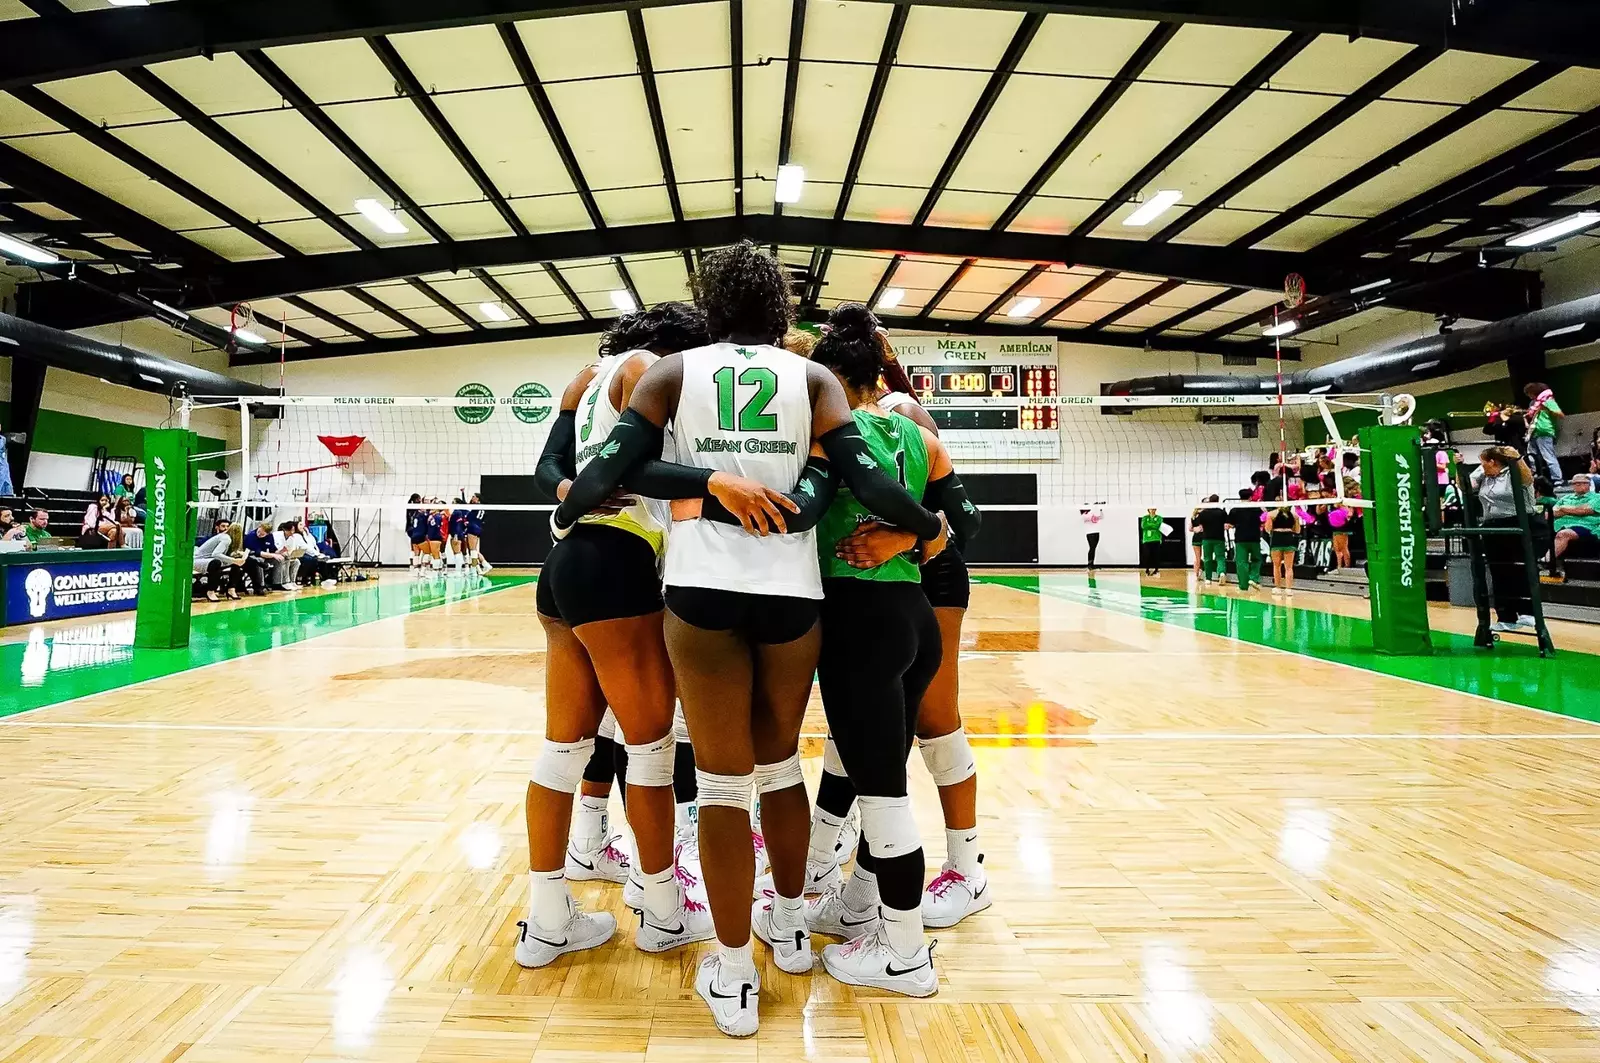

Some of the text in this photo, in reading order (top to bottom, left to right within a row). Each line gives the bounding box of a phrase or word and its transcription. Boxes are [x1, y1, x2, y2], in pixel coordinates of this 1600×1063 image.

[937, 340, 976, 349] MEAN
[1000, 341, 1052, 353] AMERICAN
[944, 351, 987, 360] GREEN
[950, 374, 984, 391] 0:00
[1002, 375, 1012, 390] 0
[713, 366, 778, 432] 12
[695, 438, 797, 454] MEAN GREEN
[151, 474, 167, 583] NORTH TEXAS
[1396, 472, 1415, 587] NORTH TEXAS
[54, 571, 139, 590] CONNECTIONS
[54, 589, 138, 606] WELLNESS GROUP
